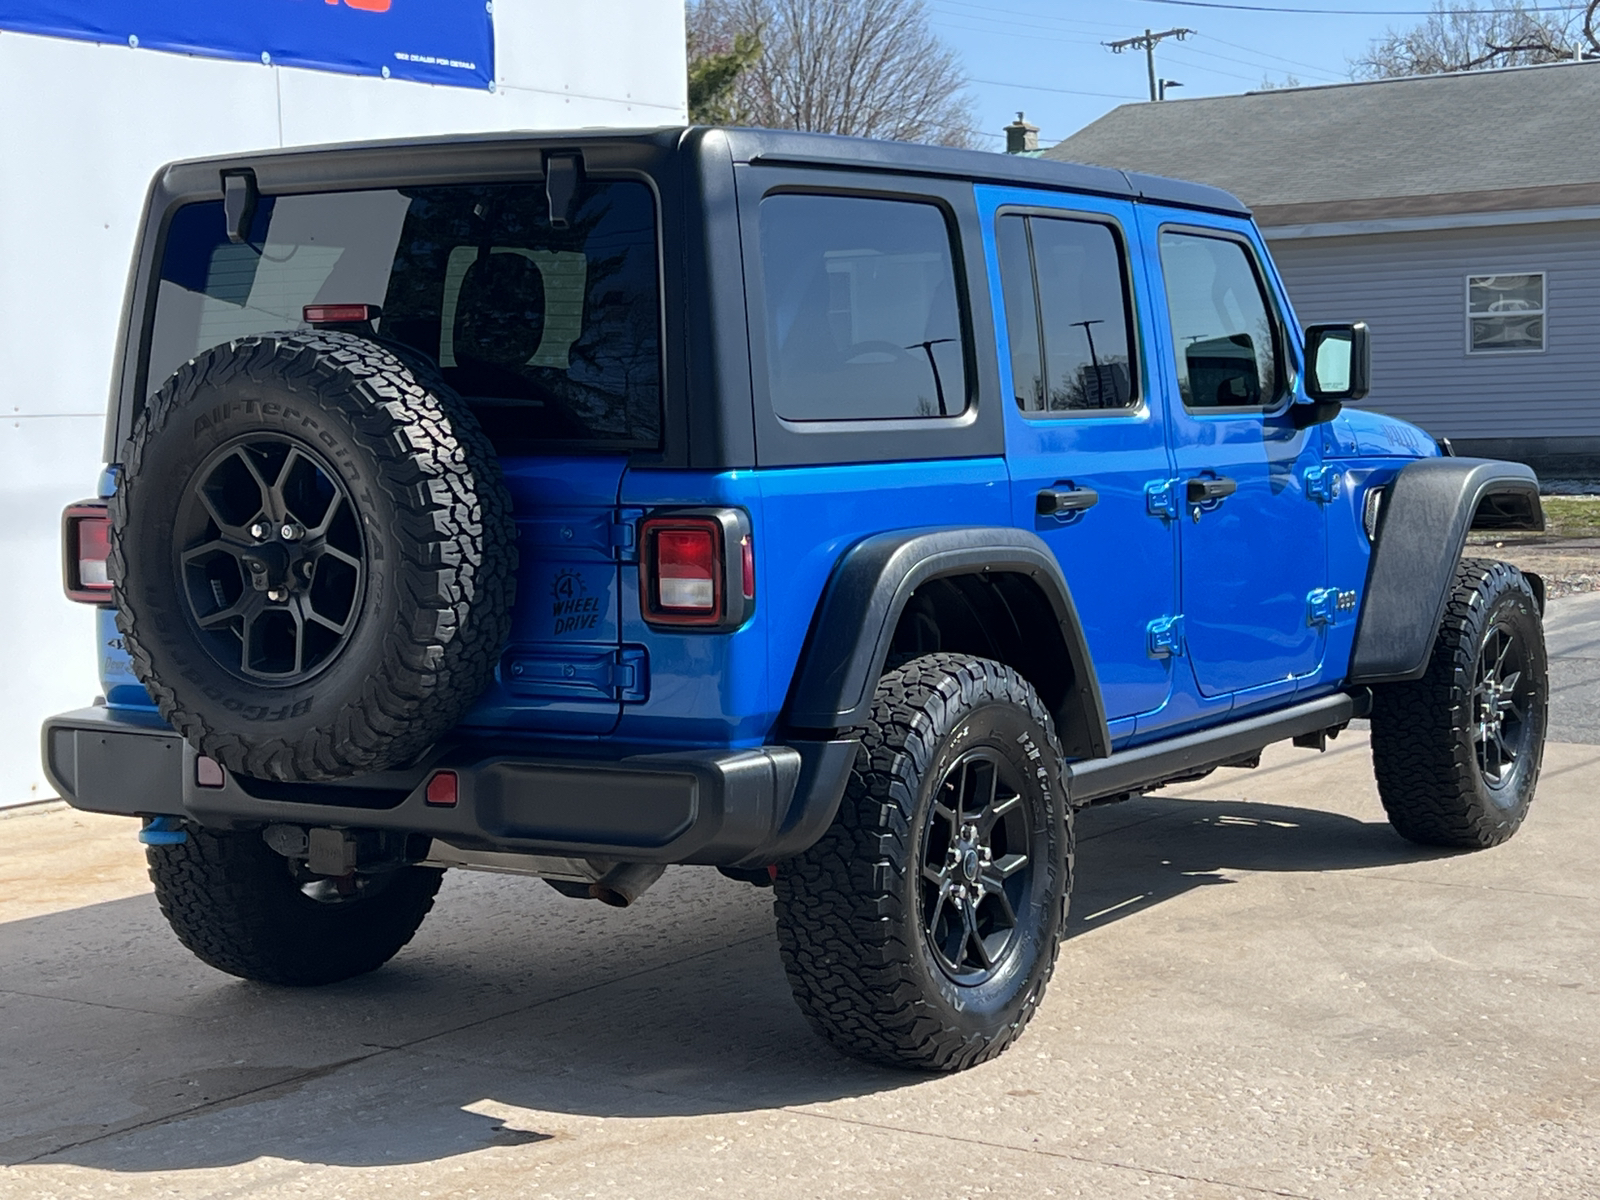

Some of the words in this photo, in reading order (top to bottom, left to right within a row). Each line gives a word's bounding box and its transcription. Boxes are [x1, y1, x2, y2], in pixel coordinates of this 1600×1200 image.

[193, 399, 361, 481] All-Terrain
[559, 577, 574, 598] 4
[553, 597, 599, 617] WHEEL
[554, 614, 599, 636] DRIVE
